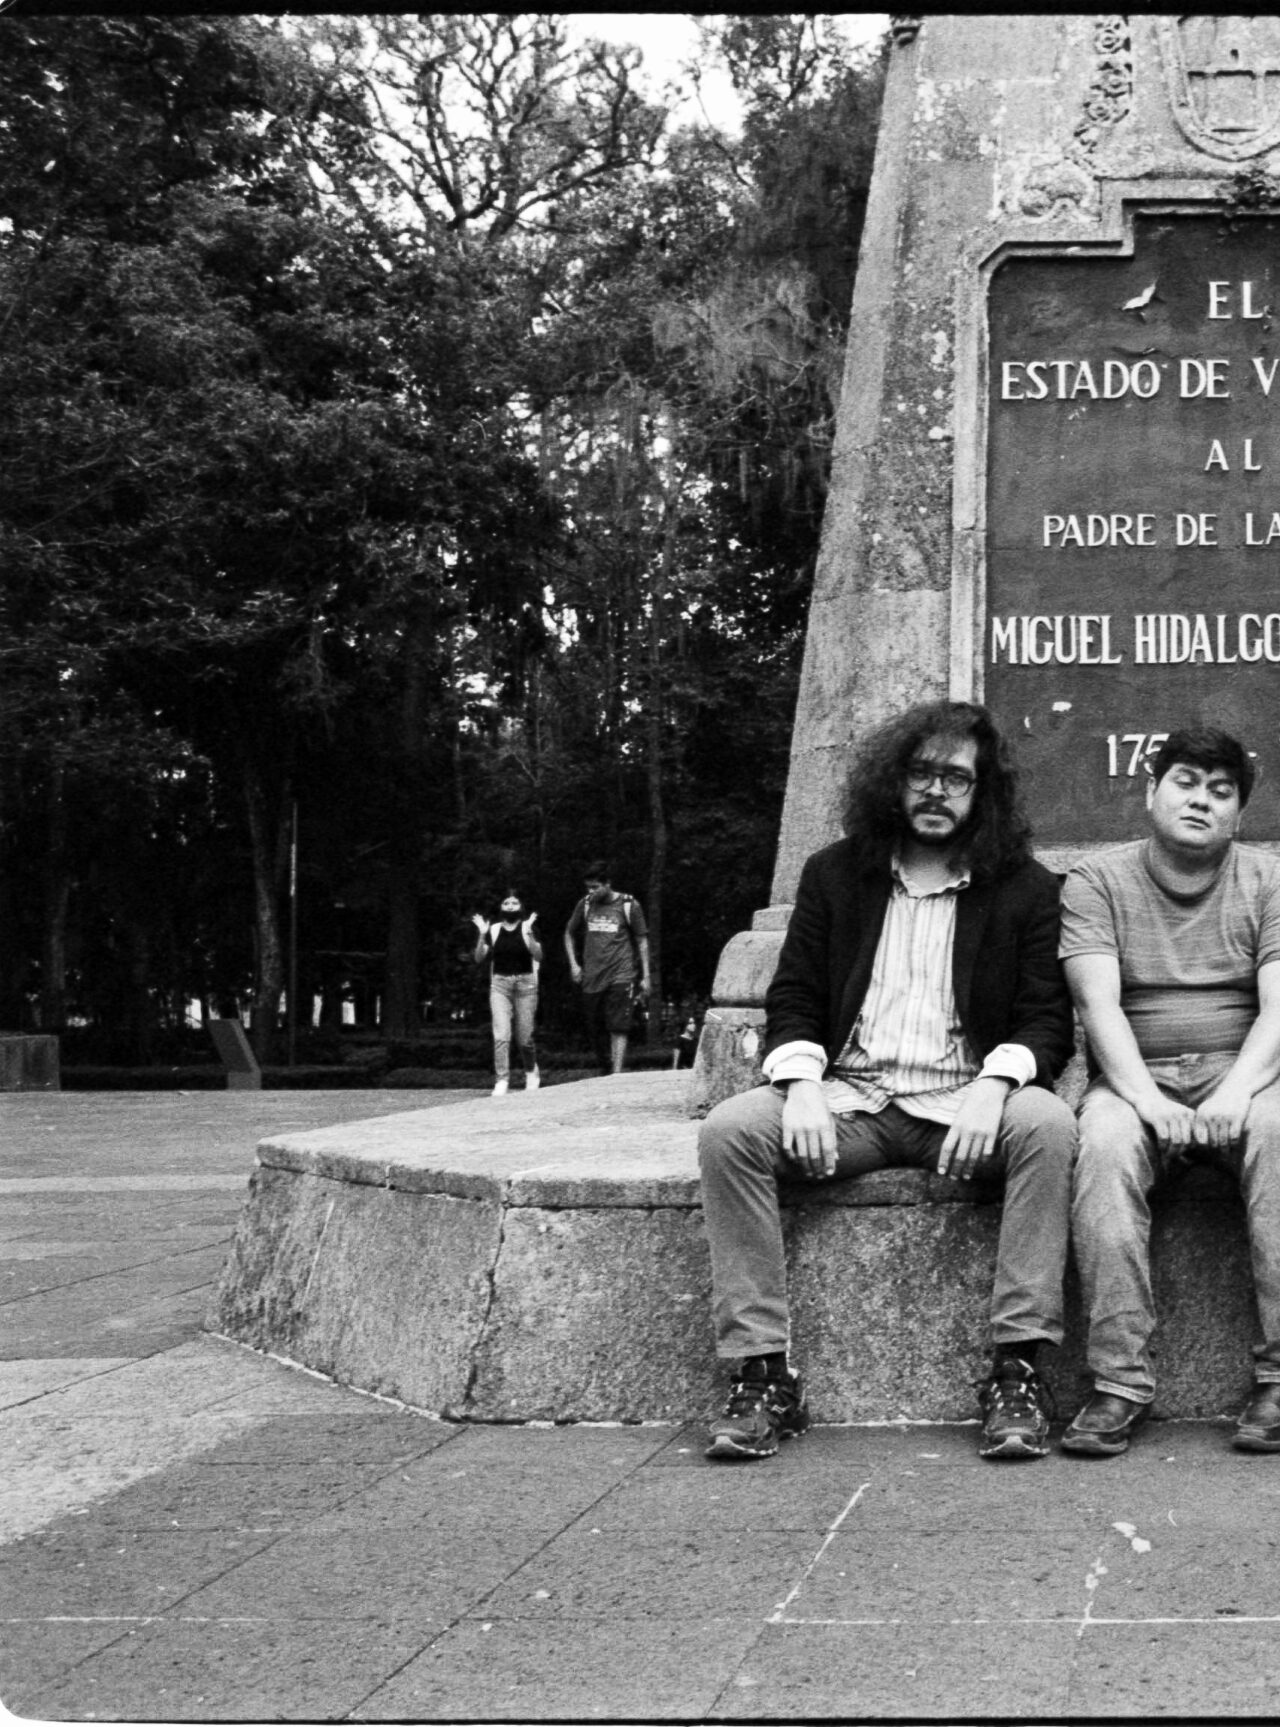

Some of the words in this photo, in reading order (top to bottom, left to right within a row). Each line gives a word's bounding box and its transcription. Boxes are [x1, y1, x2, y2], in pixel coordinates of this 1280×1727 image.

[1208, 280, 1264, 319] EL
[1001, 359, 1161, 400] ESTADO
[1179, 358, 1231, 398] DE
[1204, 438, 1262, 471] AL
[1043, 513, 1157, 547] PADRE
[1176, 512, 1218, 546] DE
[991, 614, 1122, 665] MIGUEL
[1106, 733, 1171, 777] 175
